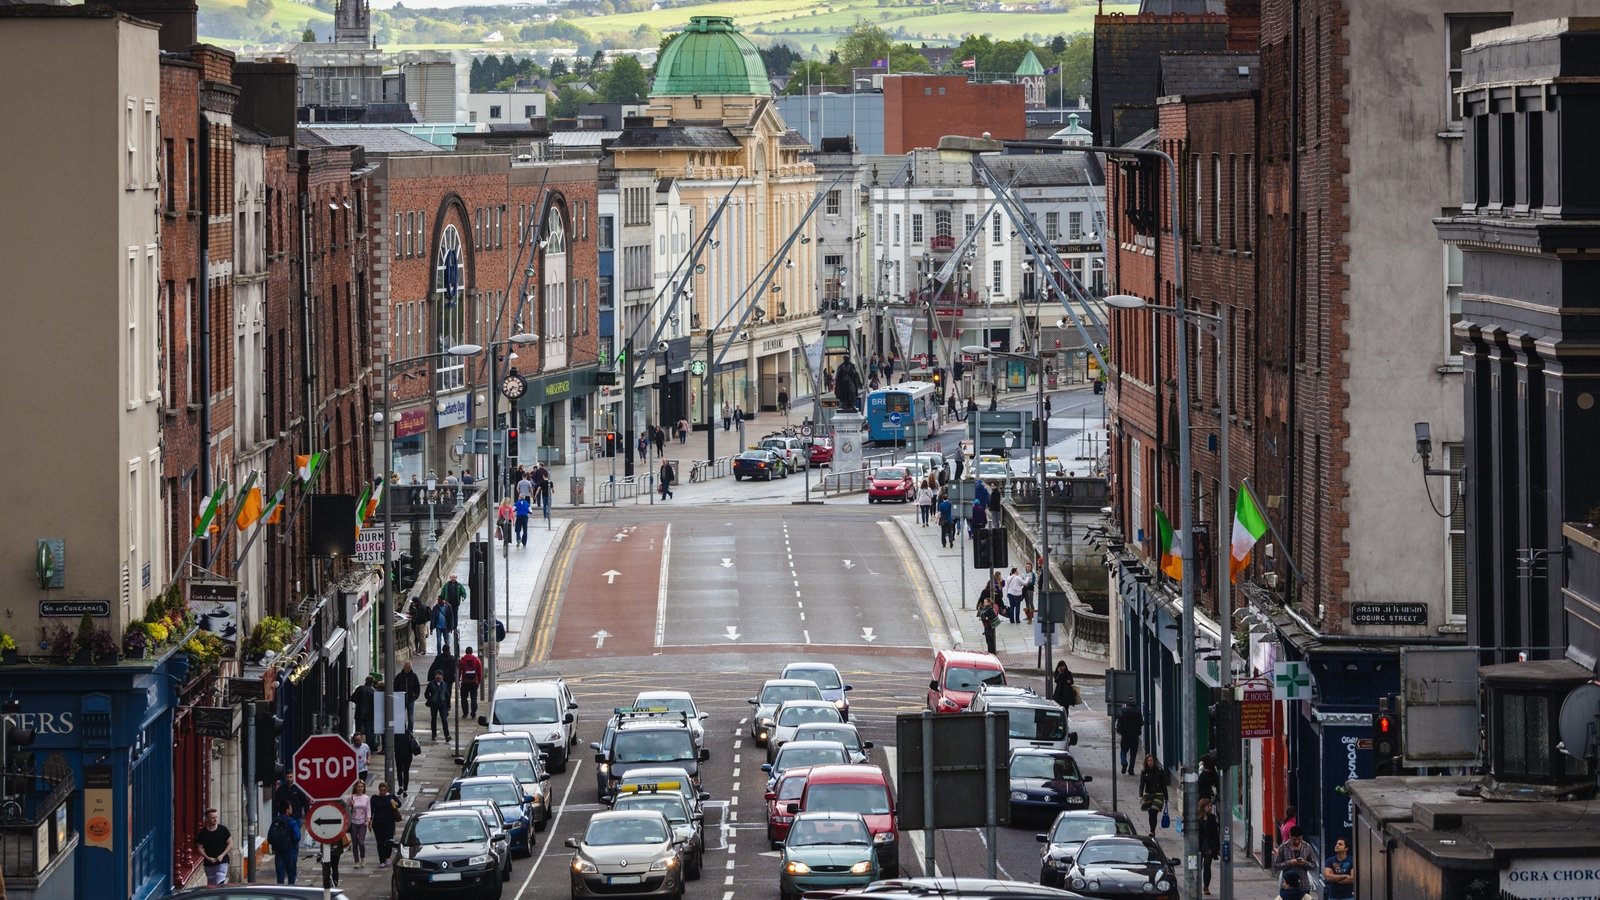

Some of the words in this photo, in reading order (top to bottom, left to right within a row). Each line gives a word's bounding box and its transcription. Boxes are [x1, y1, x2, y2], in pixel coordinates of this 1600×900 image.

[358, 531, 395, 542] OURMT
[355, 541, 396, 552] BURGE)
[358, 551, 386, 561] BISTR
[297, 756, 355, 780] STOP
